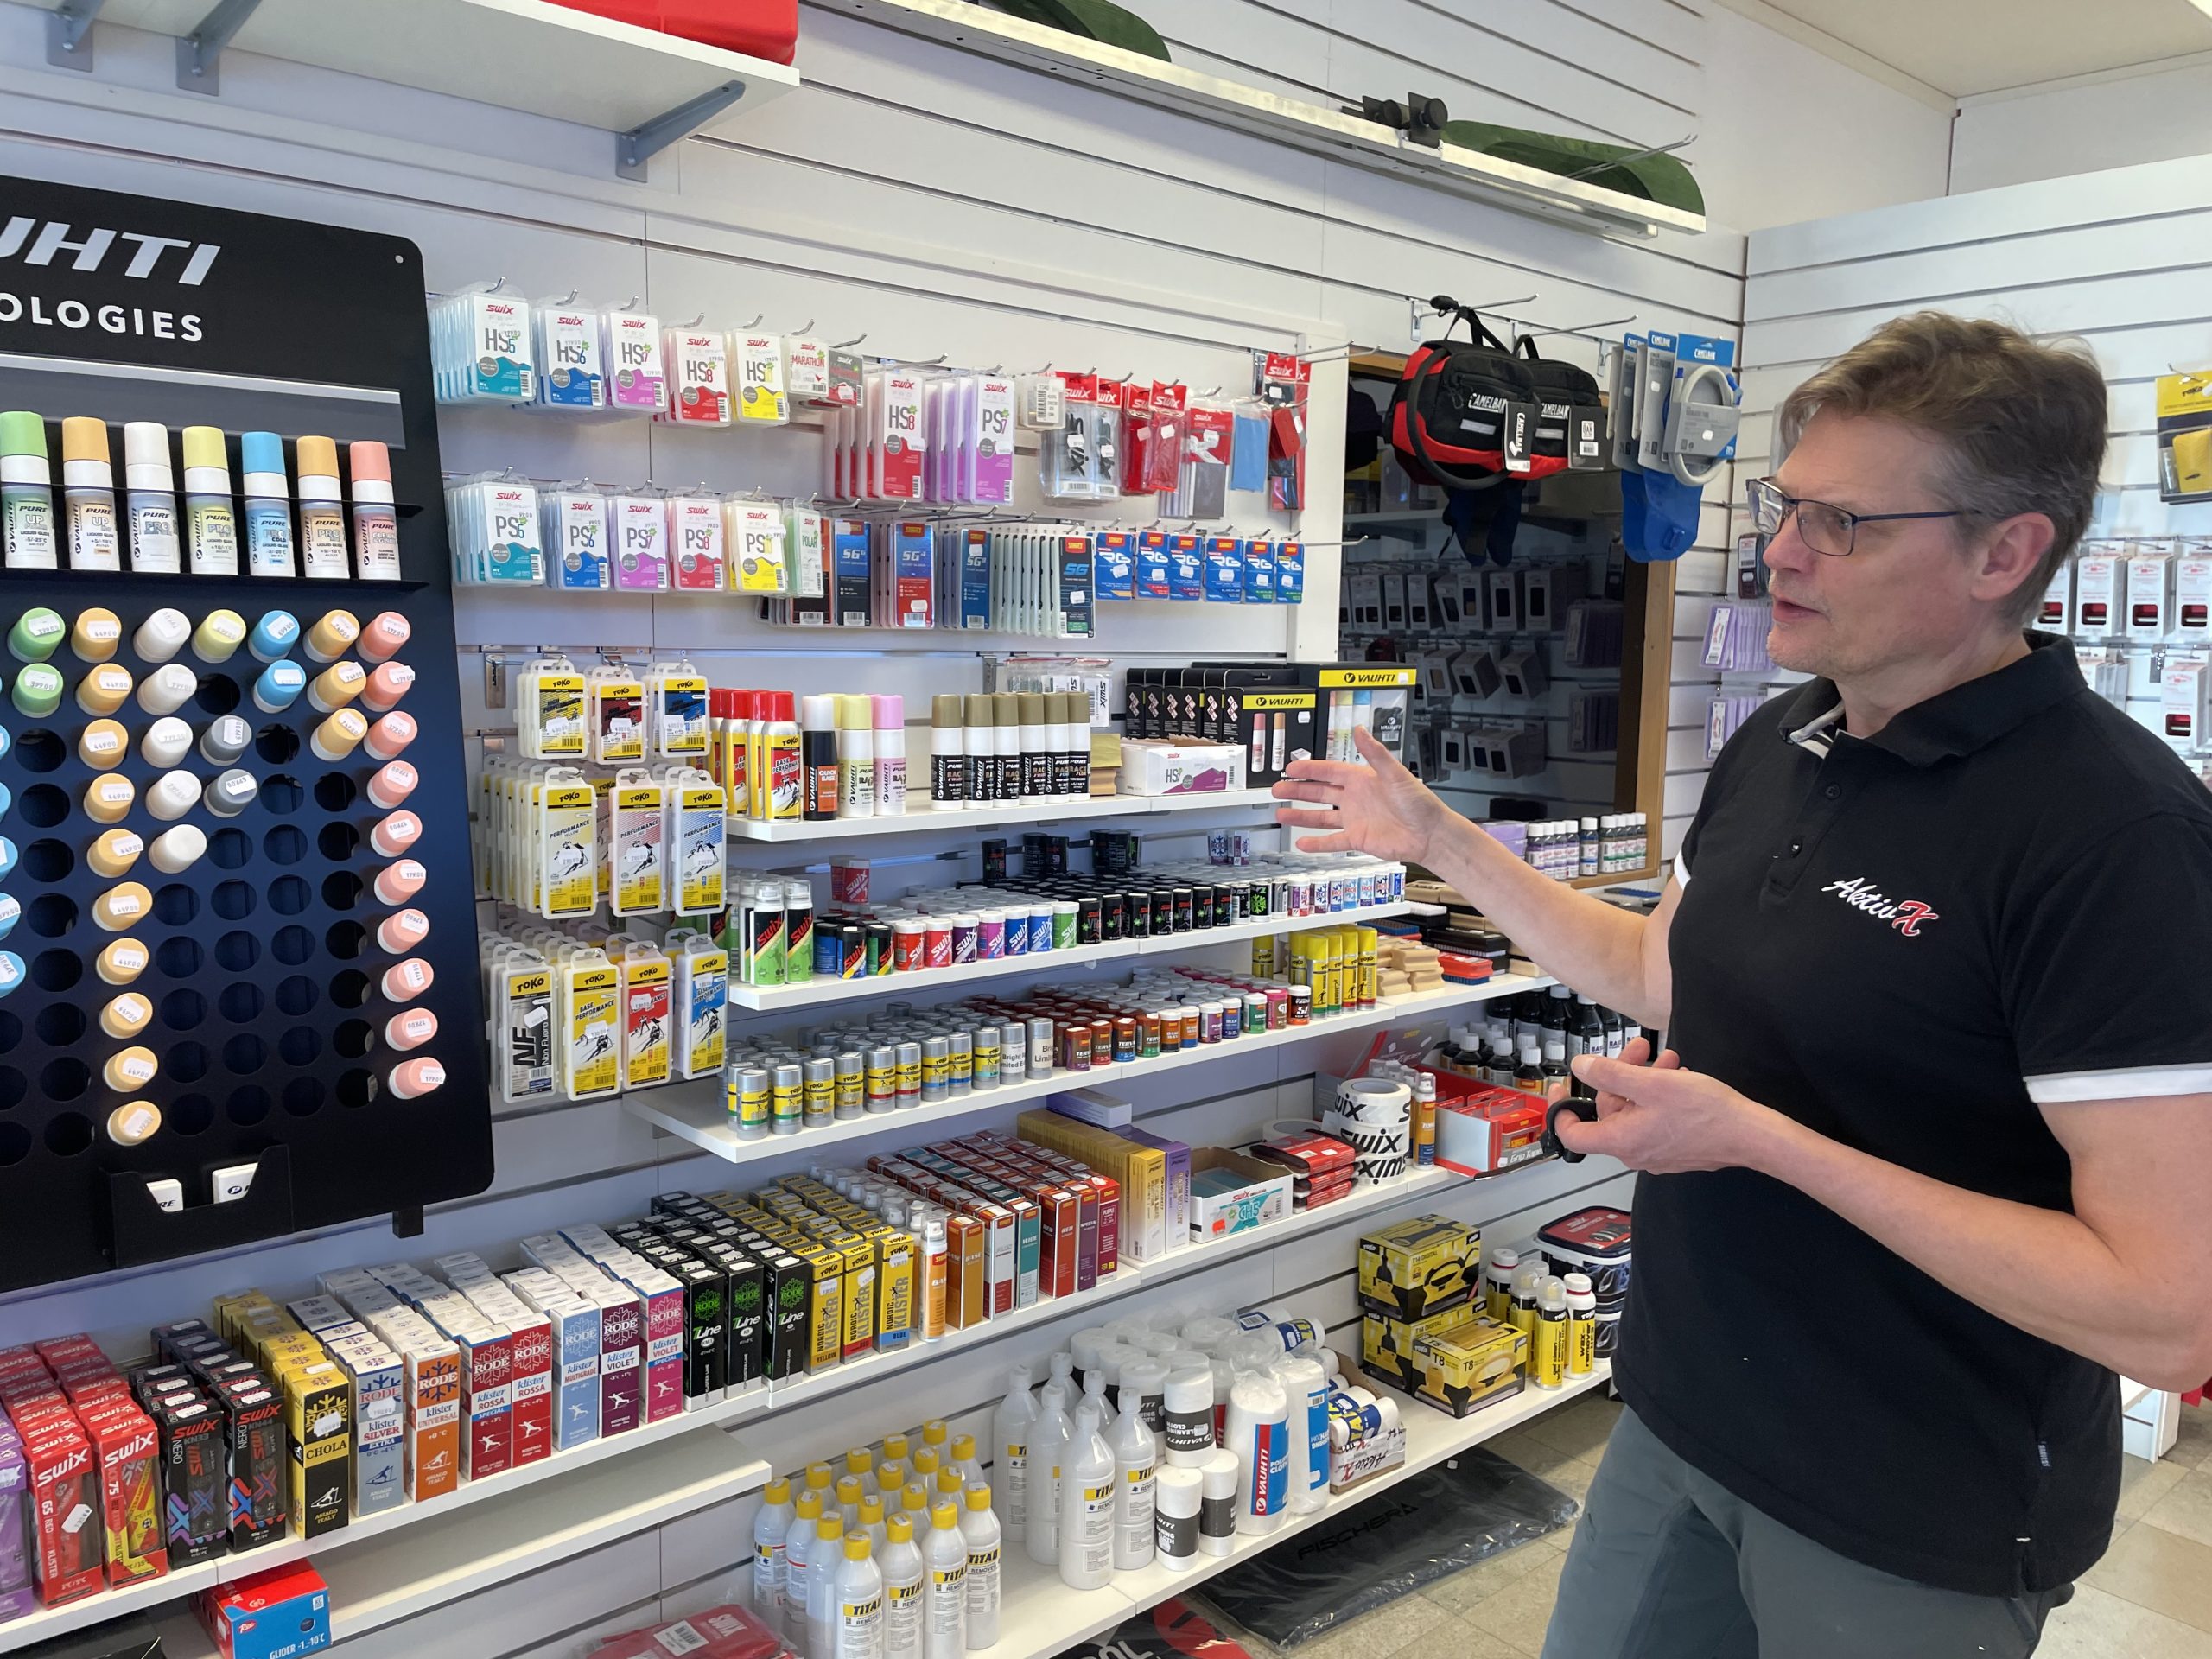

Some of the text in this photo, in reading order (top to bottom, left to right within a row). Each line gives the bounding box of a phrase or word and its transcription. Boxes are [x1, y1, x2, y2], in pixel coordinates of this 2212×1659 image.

[686, 359, 714, 383] HS8
[888, 404, 916, 431] HS8
[982, 408, 1008, 435] PS7
[495, 515, 525, 539] PS5
[569, 524, 595, 548] PS6
[1357, 673, 1395, 683] VAUHTI
[1268, 697, 1304, 707] VAUHTI
[558, 791, 581, 803] TOKO
[629, 791, 651, 803] TOKO
[693, 791, 713, 804] TOKO
[549, 819, 590, 840] PERFORMANCE
[620, 819, 659, 839] PERFORMANCE
[683, 819, 721, 839] PERFORMANCE
[701, 958, 719, 970] TOKO
[583, 973, 606, 985] TOKO
[638, 966, 659, 978] TOKO
[515, 976, 545, 993] TOKO
[575, 1000, 615, 1021] PERFORMANCE
[579, 1001, 594, 1013] BASE
[541, 1020, 550, 1066] Non Fluoro
[889, 1244, 908, 1256] TOKO
[851, 1254, 869, 1268] TOKO
[820, 1264, 838, 1277] TOKO
[649, 1307, 682, 1324] RODE
[604, 1319, 639, 1335] RODE
[564, 1330, 597, 1345] RODE
[652, 1337, 678, 1351] klister
[513, 1343, 550, 1360] RODE
[607, 1349, 634, 1363] klister
[652, 1344, 679, 1358] VIOLET
[474, 1357, 511, 1375] RODE
[607, 1357, 635, 1371] VIOLET
[653, 1354, 677, 1366] SPECIAL
[1433, 1352, 1445, 1367] T8
[1463, 1360, 1474, 1372] T8
[564, 1367, 596, 1383] MULTIGRADE
[566, 1360, 594, 1375] klister
[418, 1372, 458, 1390] RODE
[517, 1374, 547, 1389] klister
[359, 1386, 402, 1404] RODE
[476, 1388, 506, 1403] klister
[518, 1384, 546, 1397] ROSSA
[425, 1405, 454, 1418] klister
[478, 1397, 505, 1411] ROSSA
[417, 1411, 458, 1429] UNIVERSAL
[478, 1407, 505, 1420] SPECIAL
[368, 1417, 397, 1432] klister
[236, 1424, 247, 1450] NERO
[363, 1426, 400, 1442] SILVER
[306, 1440, 347, 1460] CHOLA
[369, 1438, 395, 1449] EXTRA
[173, 1439, 183, 1465] NERO
[1258, 1448, 1268, 1495] VAUHTI
[107, 1479, 119, 1497] 75
[41, 1500, 53, 1516] 65
[315, 1508, 339, 1521] ASIAGO
[45, 1516, 54, 1534] RED
[317, 1513, 337, 1524] ITALY
[1299, 1505, 1402, 1561] FISCHER
[970, 1563, 997, 1574] REMOVER
[270, 1644, 296, 1659] GLIDER
